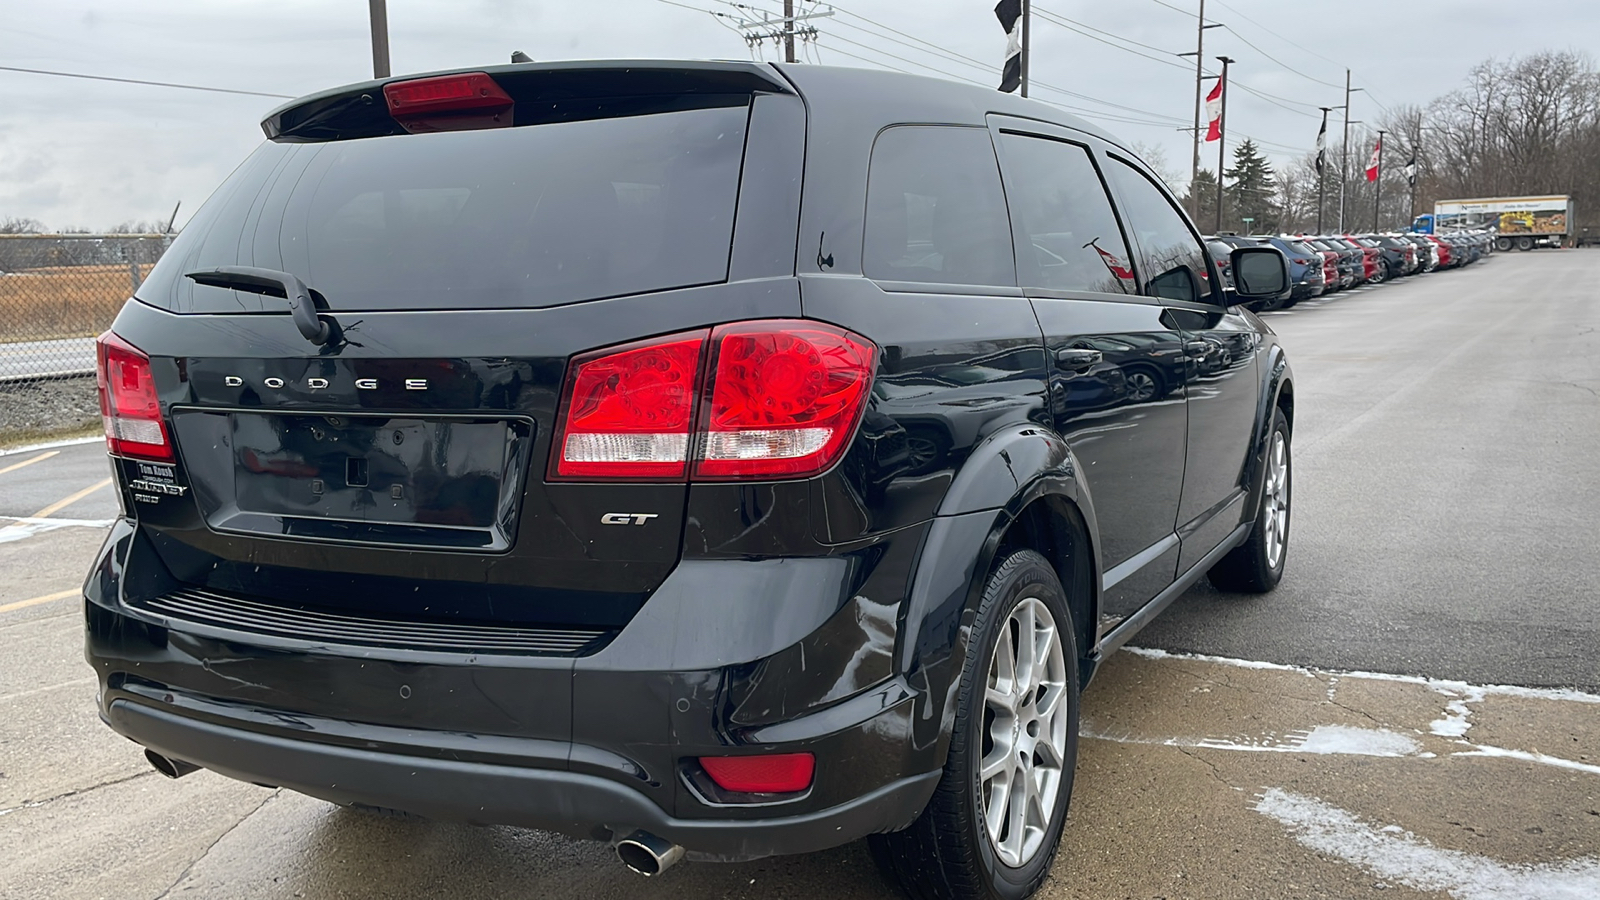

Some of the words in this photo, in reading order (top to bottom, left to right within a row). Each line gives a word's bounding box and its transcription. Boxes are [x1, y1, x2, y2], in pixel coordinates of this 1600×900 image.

[225, 376, 428, 390] DODGE
[139, 464, 153, 475] Tom
[153, 465, 174, 477] Roush
[129, 479, 187, 496] JOURNEY
[600, 512, 659, 525] GT
